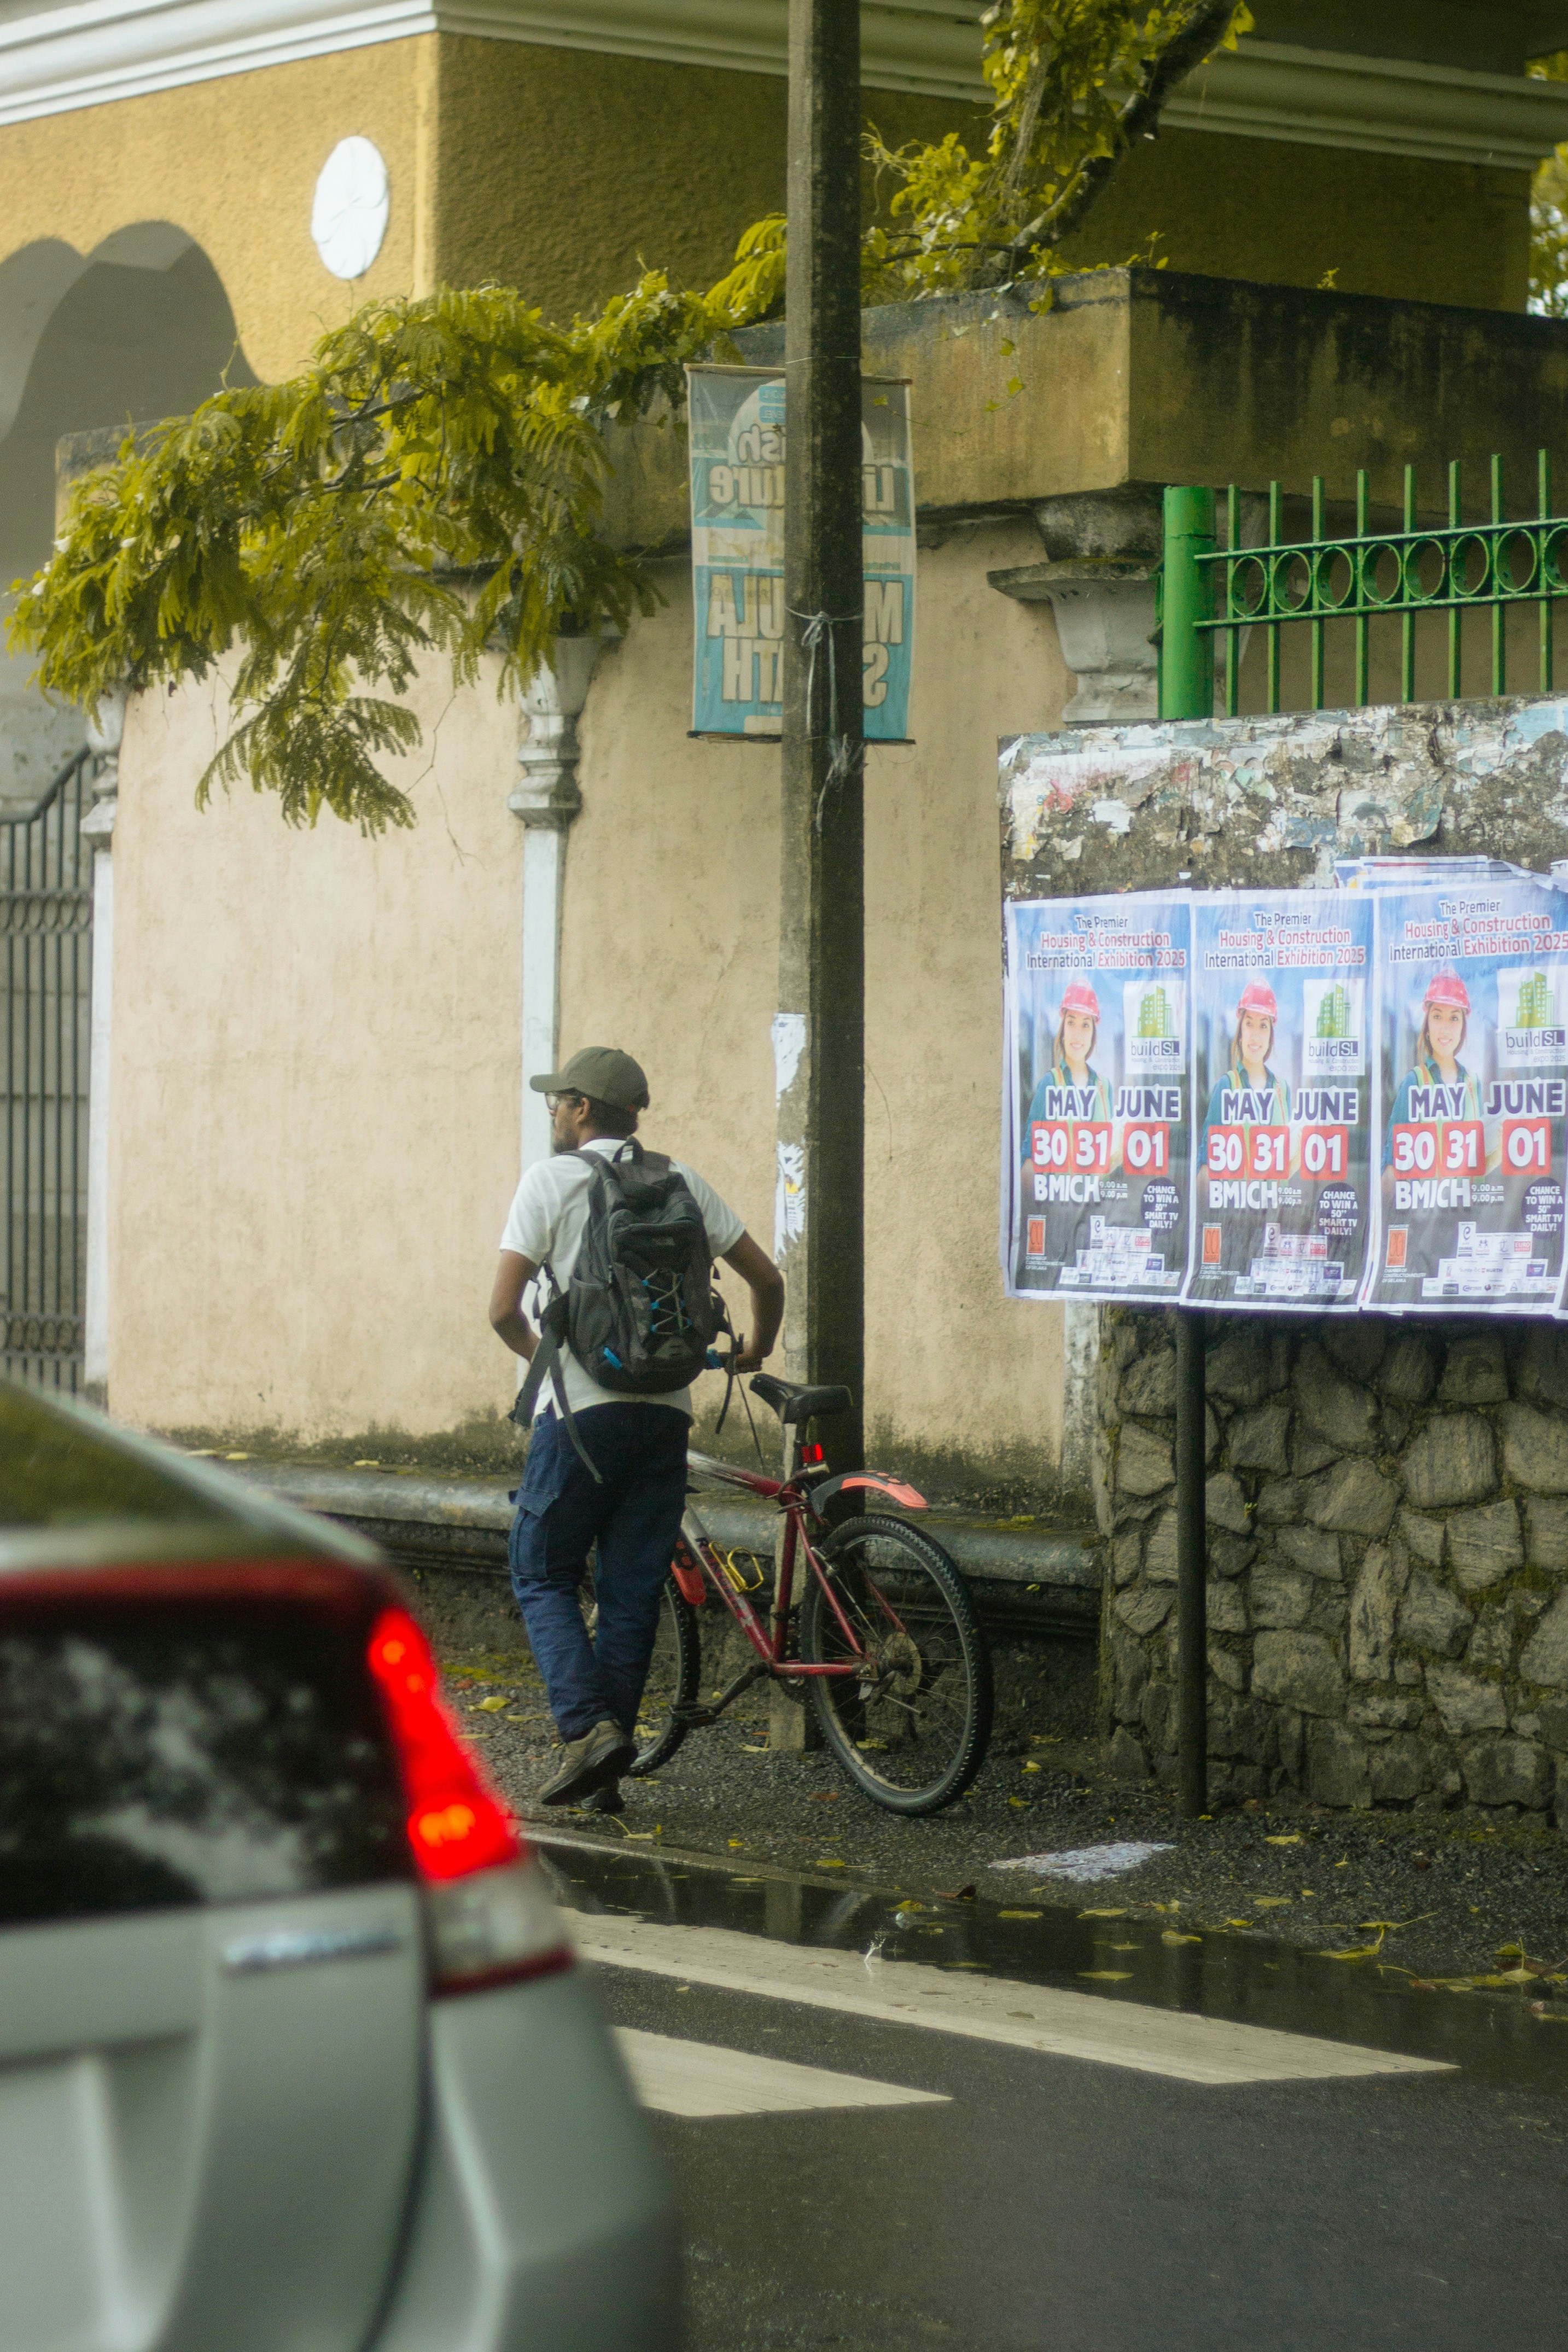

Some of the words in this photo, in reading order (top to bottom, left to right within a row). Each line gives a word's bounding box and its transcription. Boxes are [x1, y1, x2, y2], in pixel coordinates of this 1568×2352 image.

[1440, 903, 1456, 916] The
[1460, 899, 1500, 913] Premier
[1076, 916, 1092, 929] The
[1094, 916, 1128, 928] Premier
[1255, 913, 1272, 925] The
[1274, 912, 1311, 925] Premier
[1405, 921, 1448, 940] Housing
[1451, 918, 1460, 935] &
[1463, 913, 1550, 934] Construction
[1041, 933, 1086, 952] Housing
[1088, 932, 1097, 947] &
[1098, 931, 1170, 947] Construction
[1220, 930, 1263, 950] Housing
[1267, 929, 1274, 945] &
[1278, 928, 1350, 944] Construction
[1390, 940, 1460, 960] International
[1464, 936, 1530, 955] Exhibition
[1534, 933, 1568, 951] 2025
[1027, 952, 1095, 968] International
[1098, 952, 1153, 967] Exhibition
[1156, 951, 1185, 967] 2025
[1205, 950, 1273, 967] International
[1277, 949, 1333, 965] Exhibition
[1338, 948, 1365, 964] 2025
[1506, 1030, 1565, 1047] buildSL
[1131, 1040, 1179, 1056] buildSL
[1309, 1041, 1358, 1056] buildSL
[1047, 1088, 1095, 1117] MAY
[1115, 1088, 1179, 1118] JUNE
[1223, 1092, 1272, 1120] MAY
[1294, 1091, 1356, 1120] JUNE
[1411, 1086, 1464, 1118] MAY
[1487, 1082, 1563, 1115] JUNE
[1034, 1128, 1068, 1166] 30
[1075, 1129, 1108, 1167] 31
[1127, 1130, 1164, 1167] 01
[1209, 1133, 1243, 1171] 30
[1254, 1133, 1285, 1171] 31
[1304, 1133, 1342, 1172] 01
[1395, 1131, 1435, 1171] 30
[1447, 1129, 1477, 1168] 31
[1508, 1127, 1546, 1167] 01
[1034, 1174, 1101, 1202] BMICH
[1147, 1185, 1176, 1194] CHANCE
[1209, 1180, 1278, 1209] BMICH
[1323, 1191, 1355, 1200] CHANCE
[1395, 1178, 1471, 1209] BMICH
[1530, 1185, 1560, 1195] CHANCE
[1143, 1194, 1154, 1202] TO
[1156, 1194, 1172, 1203] WIN
[1173, 1195, 1179, 1203] A
[1331, 1201, 1350, 1209] WIN
[1525, 1196, 1537, 1204] TO
[1538, 1195, 1555, 1204] WIN
[1149, 1220, 1173, 1229] DAILY!
[1168, 1212, 1179, 1220] TV
[1319, 1218, 1346, 1226] SMART
[1348, 1219, 1357, 1227] TV
[1526, 1214, 1551, 1223] SMART
[1552, 1213, 1563, 1222] TV
[1324, 1227, 1352, 1235] DAILY!
[1531, 1223, 1557, 1231] DAILY!
